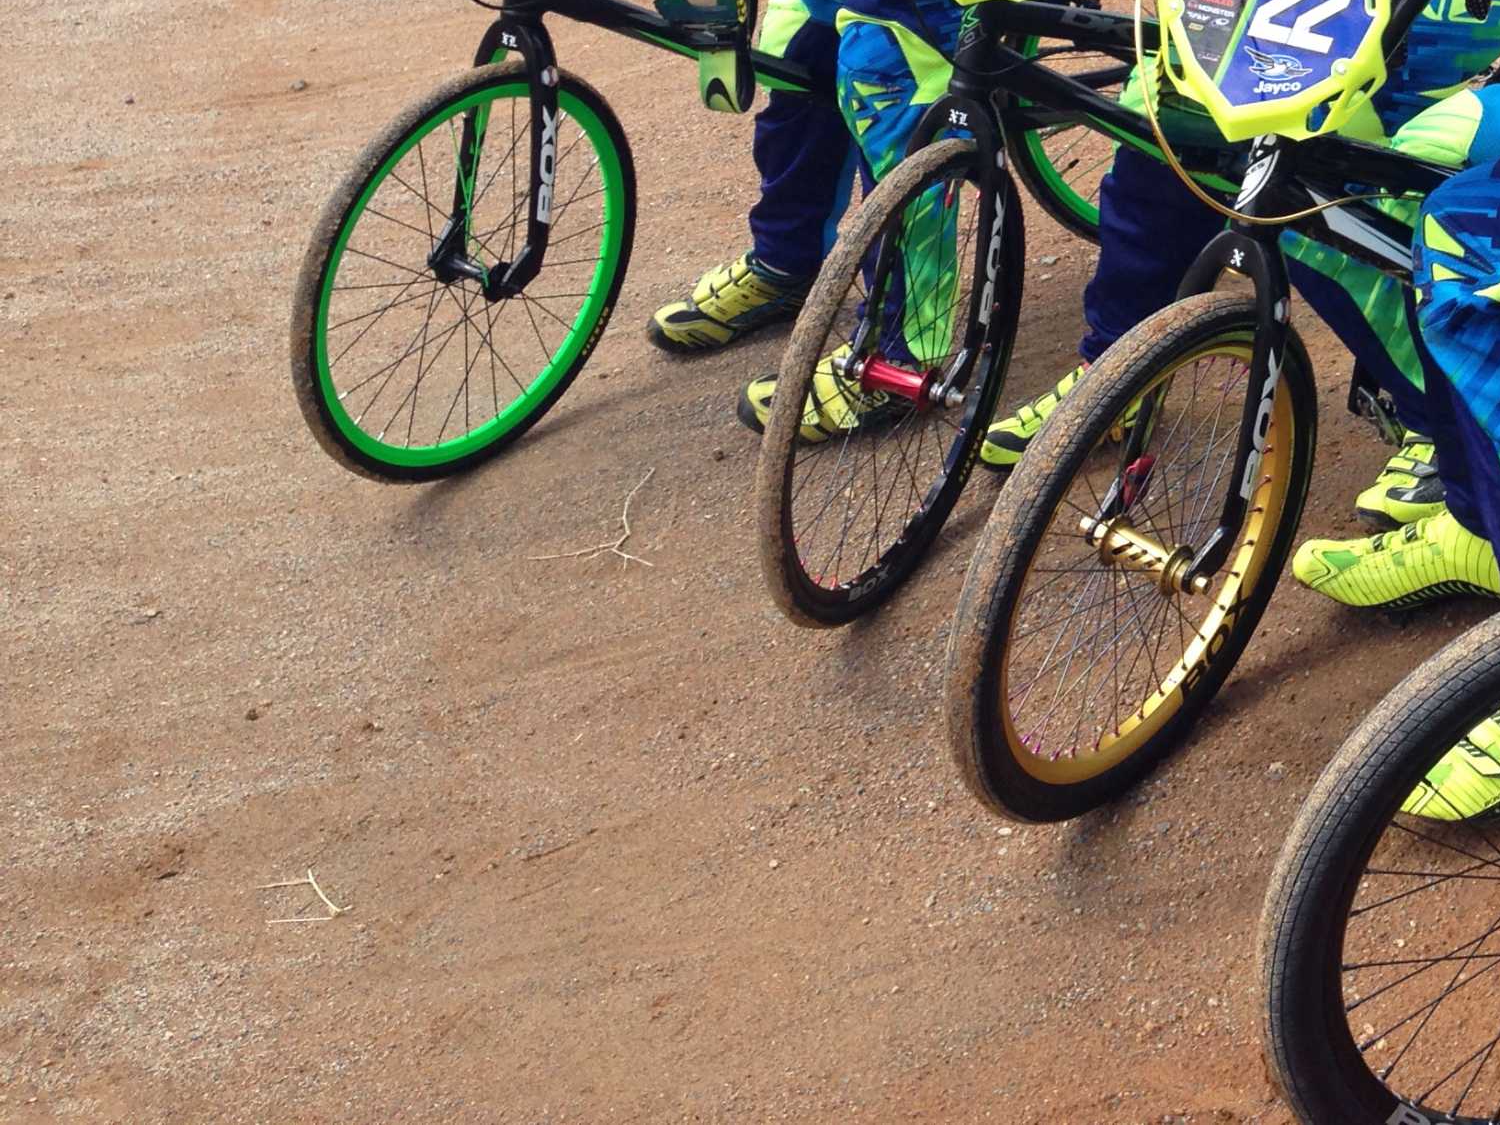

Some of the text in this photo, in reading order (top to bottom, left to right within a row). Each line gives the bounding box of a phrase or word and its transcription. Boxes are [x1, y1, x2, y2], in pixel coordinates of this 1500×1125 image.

[1253, 80, 1301, 95] Jayco
[536, 105, 558, 225] BOX
[978, 191, 1004, 326] BOX
[1239, 347, 1281, 500] BOX
[1180, 591, 1250, 701] BOX
